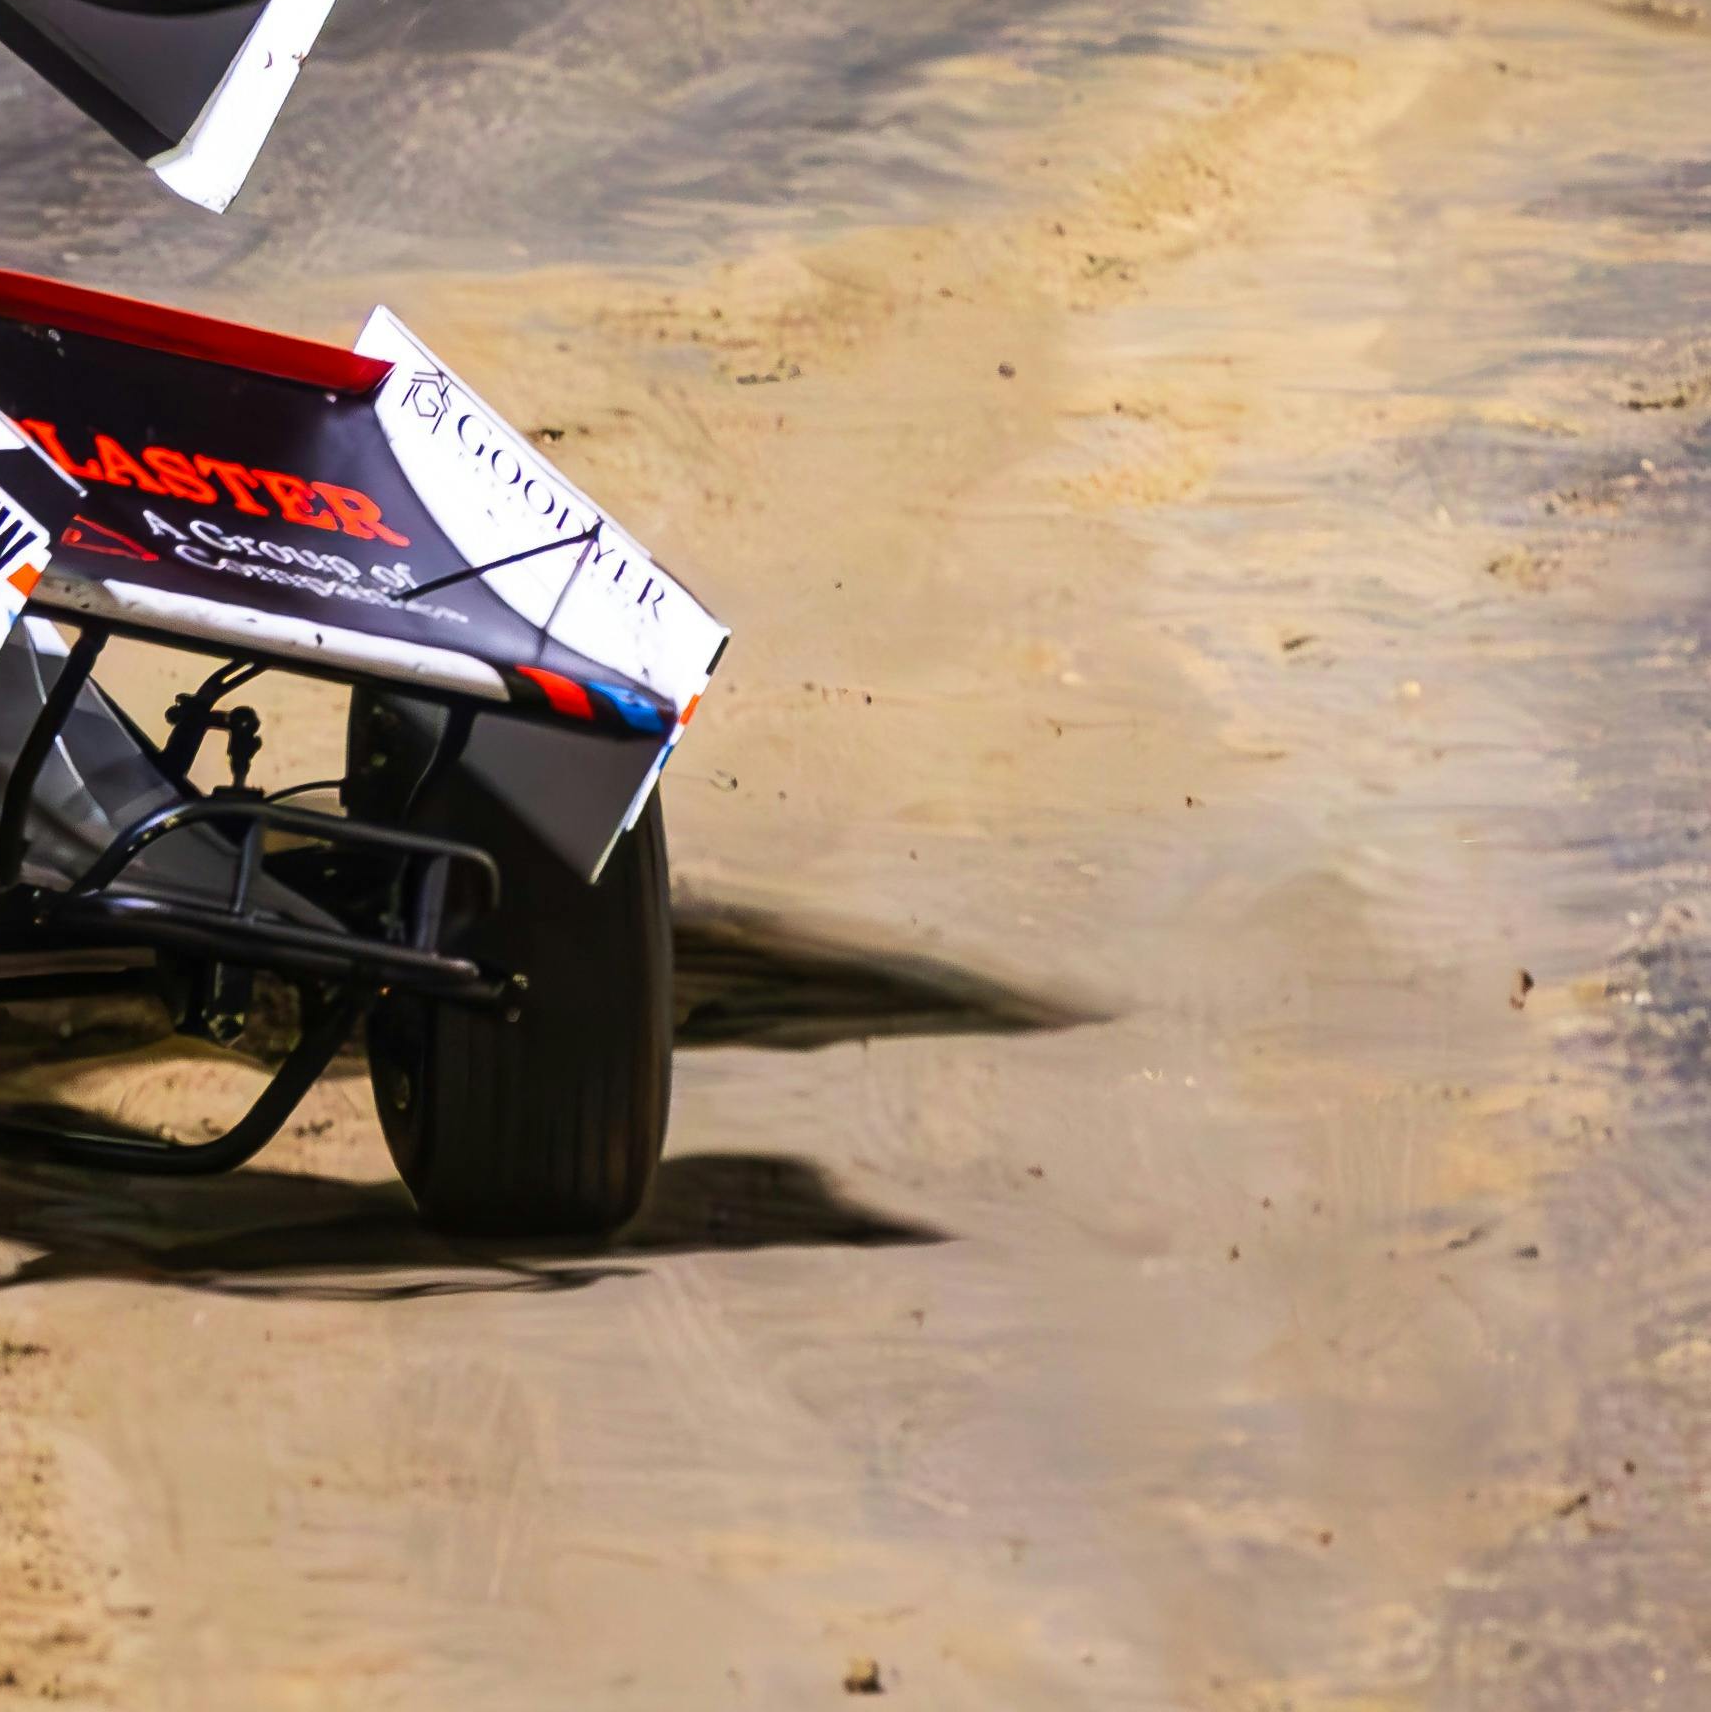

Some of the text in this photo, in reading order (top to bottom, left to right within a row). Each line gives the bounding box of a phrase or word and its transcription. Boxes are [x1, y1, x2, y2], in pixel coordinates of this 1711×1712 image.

[142, 509, 421, 590] A Group of
